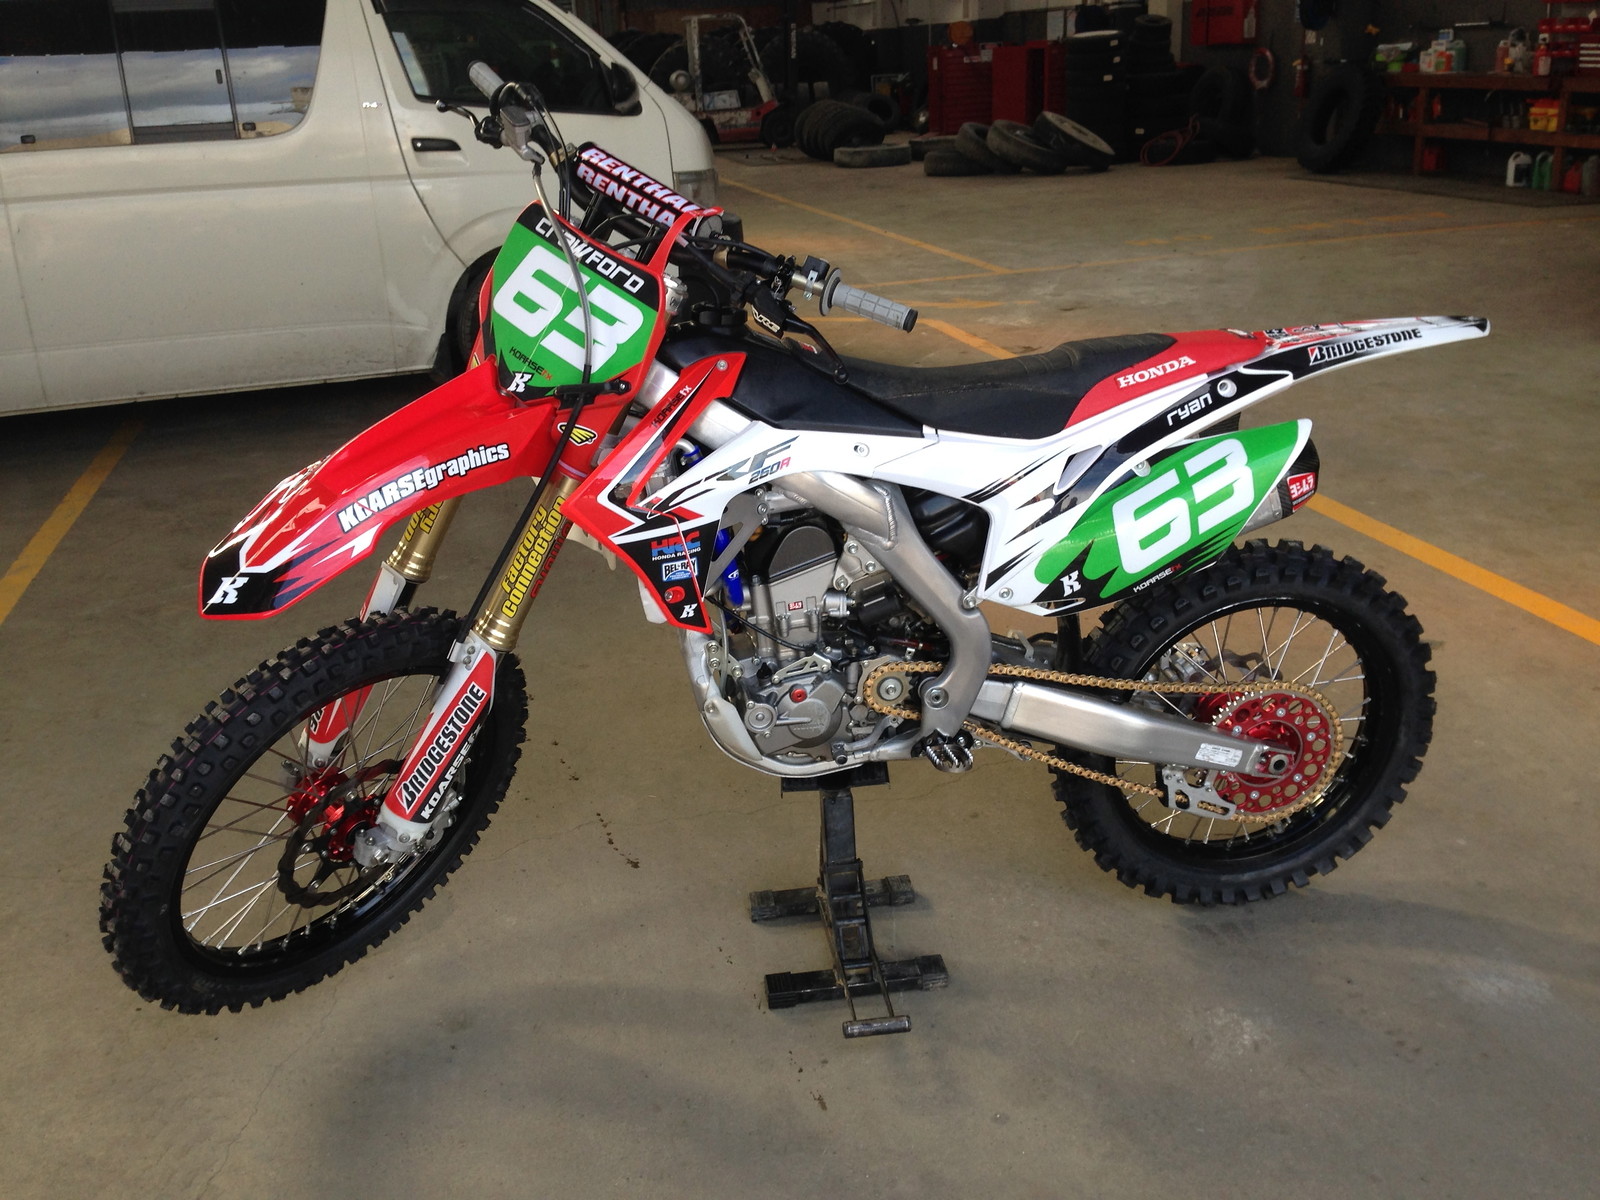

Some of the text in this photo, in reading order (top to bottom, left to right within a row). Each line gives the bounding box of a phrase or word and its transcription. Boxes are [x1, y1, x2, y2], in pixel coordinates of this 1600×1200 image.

[492, 244, 644, 374] 63
[1308, 328, 1423, 366] BRIDGESTONE
[507, 371, 533, 393] K
[1117, 355, 1197, 388] HONDA
[1112, 438, 1255, 575] 63
[652, 546, 701, 561] HONDA RACING
[1060, 570, 1081, 598] K
[680, 603, 698, 619] K
[395, 682, 487, 814] BRIDGESTONE
